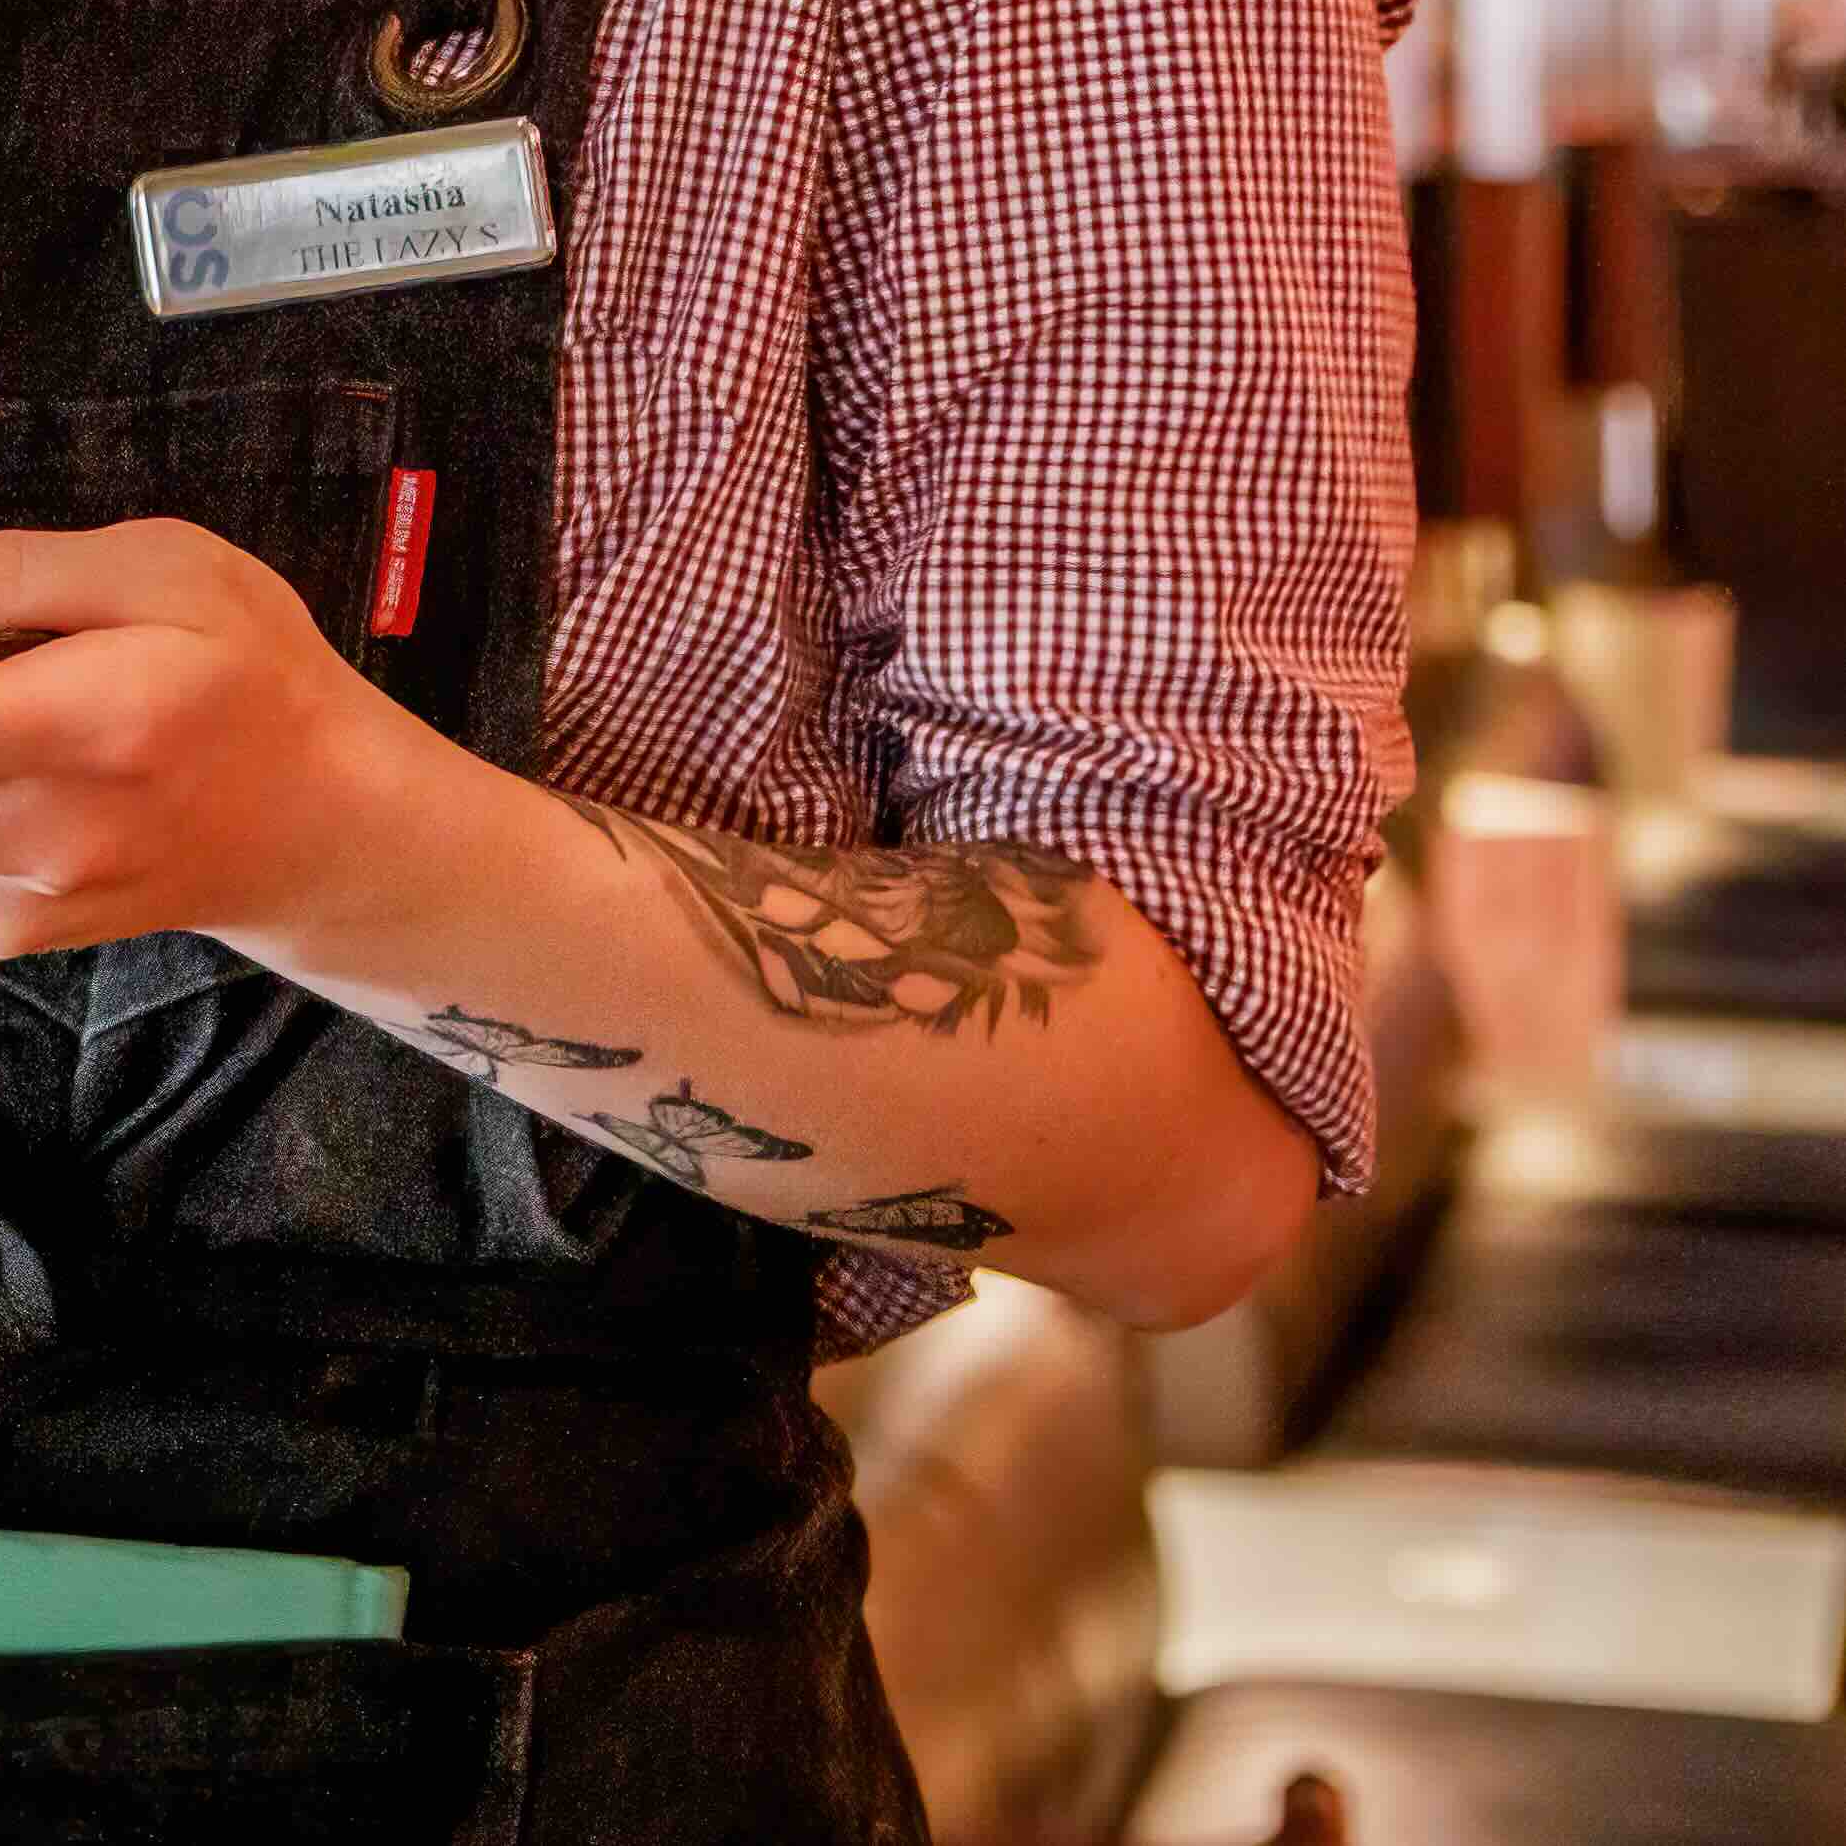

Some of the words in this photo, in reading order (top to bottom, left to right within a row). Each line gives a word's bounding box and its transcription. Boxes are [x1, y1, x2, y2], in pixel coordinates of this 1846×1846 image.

[314, 179, 467, 227] Natasha
[292, 239, 365, 276] THE
[371, 224, 467, 264] LAZY
